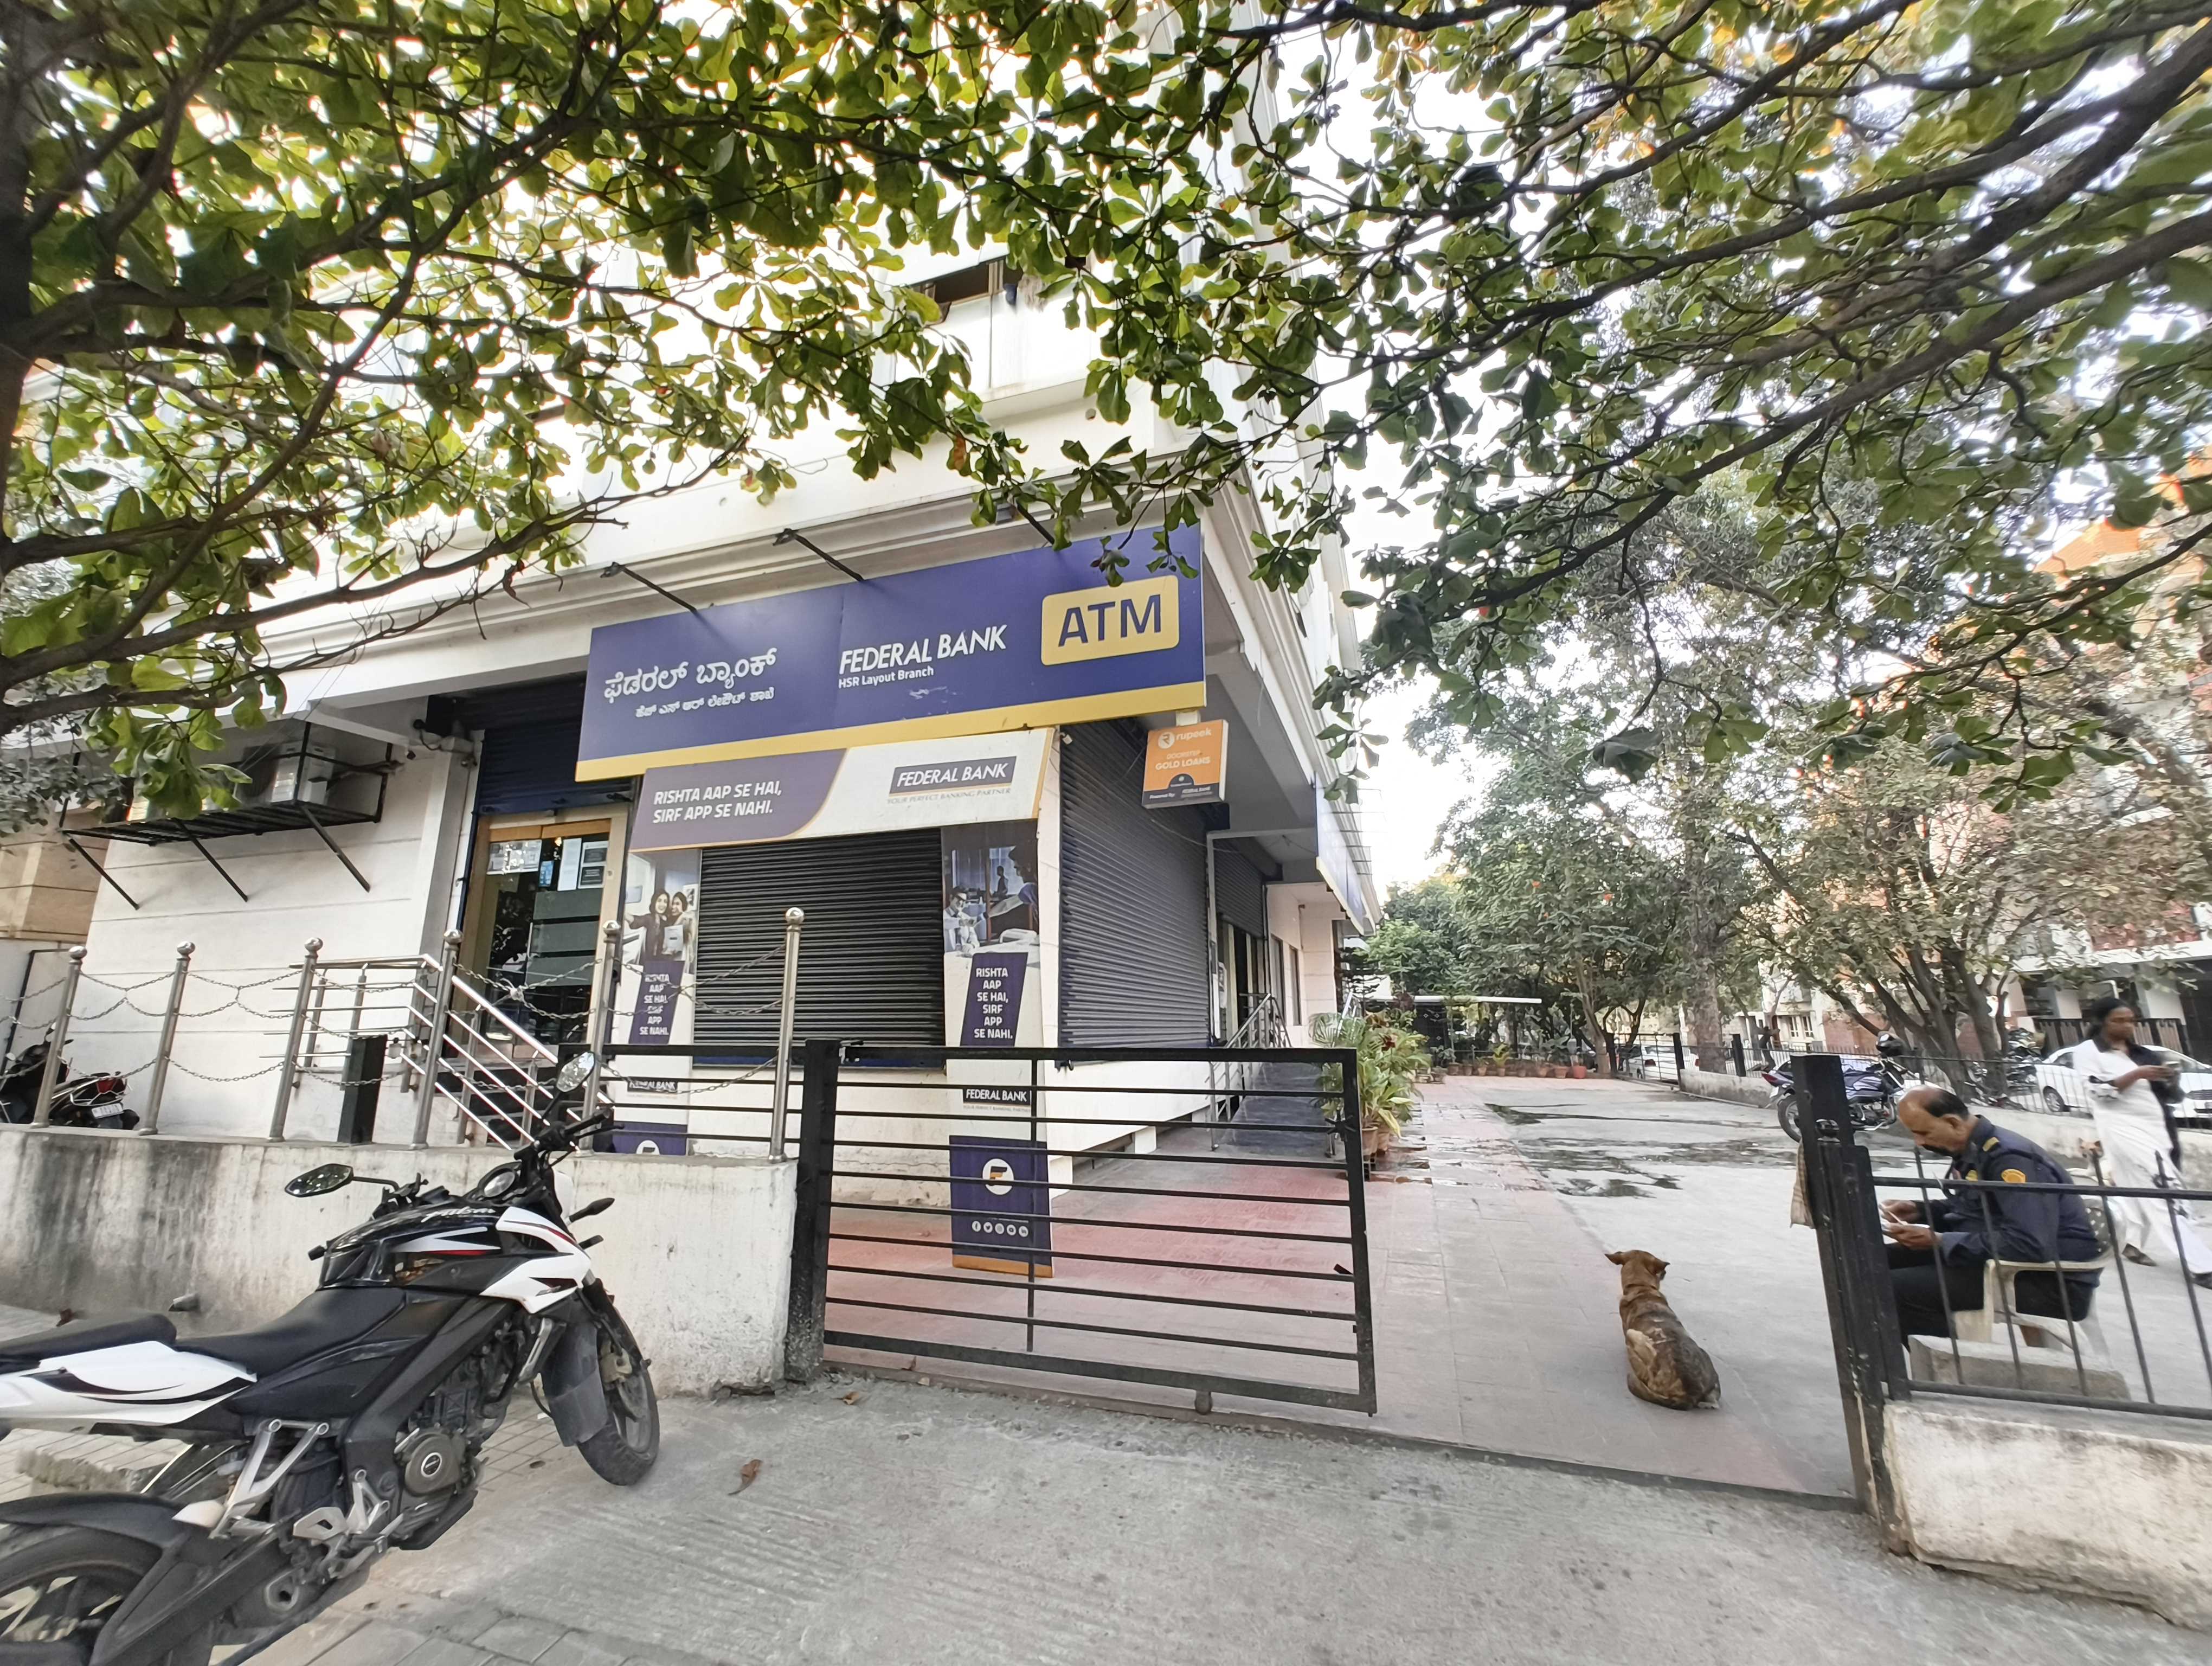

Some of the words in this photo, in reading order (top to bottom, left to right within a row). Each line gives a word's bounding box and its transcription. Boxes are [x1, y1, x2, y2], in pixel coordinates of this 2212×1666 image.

[1058, 594, 1161, 648] ATM
[839, 638, 933, 675] FEDERAL
[937, 624, 1007, 659] BANK
[603, 661, 689, 703] ಫೆಡರಲ್
[696, 647, 777, 689] ಬ್ಯಾಂಕ್
[838, 676, 859, 689] HSR
[861, 671, 896, 686] Layout
[898, 665, 934, 681] Branch
[1176, 727, 1212, 741] rupeek
[1155, 760, 1180, 770] GOLD
[1182, 757, 1211, 767] LOANS
[897, 767, 958, 787] FEDERAL
[961, 762, 1009, 781] BANK
[653, 788, 700, 805] RISHTA
[703, 785, 731, 800] AAP
[734, 783, 752, 798] SE
[754, 780, 782, 796] HAI,
[653, 808, 683, 823] SIRF
[684, 805, 712, 820] APP
[713, 803, 732, 818] SE
[734, 800, 773, 816] NAHI.
[976, 967, 1008, 977] RISHTA
[983, 980, 1002, 989] AAP
[644, 995, 653, 1003] SE
[977, 992, 988, 1002] SE
[990, 992, 1008, 1003] HAI,
[982, 1004, 1003, 1014] SIRF
[983, 1016, 1002, 1026] APP
[639, 1027, 648, 1035] SE
[974, 1028, 986, 1038] SE
[987, 1029, 1013, 1039] NAHI.
[966, 1088, 1000, 1100] FEDERAL
[1002, 1090, 1027, 1102] BANK
